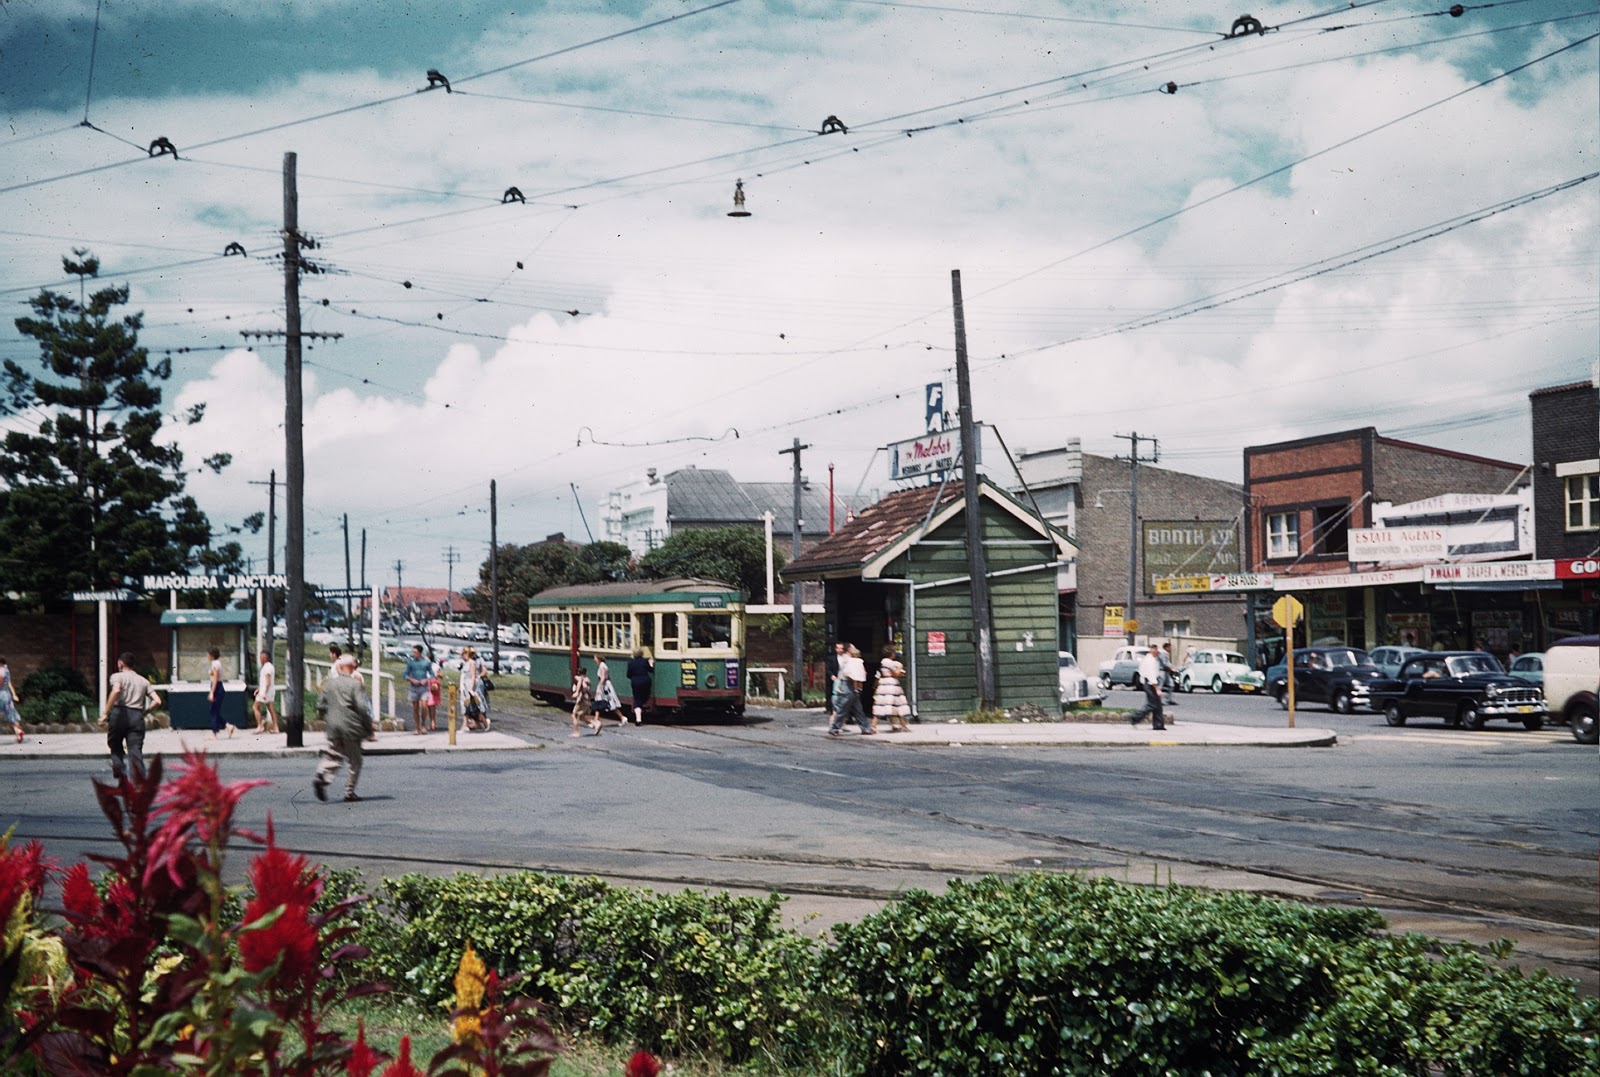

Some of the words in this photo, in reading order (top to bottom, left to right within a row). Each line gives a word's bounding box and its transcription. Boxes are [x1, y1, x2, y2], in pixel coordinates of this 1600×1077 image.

[1148, 529, 1205, 546] BOOTH
[1355, 531, 1393, 544] ESTATE
[1401, 529, 1443, 542] AGENTS
[143, 575, 218, 589] MAROUBRA
[223, 575, 288, 588] JUNCTION
